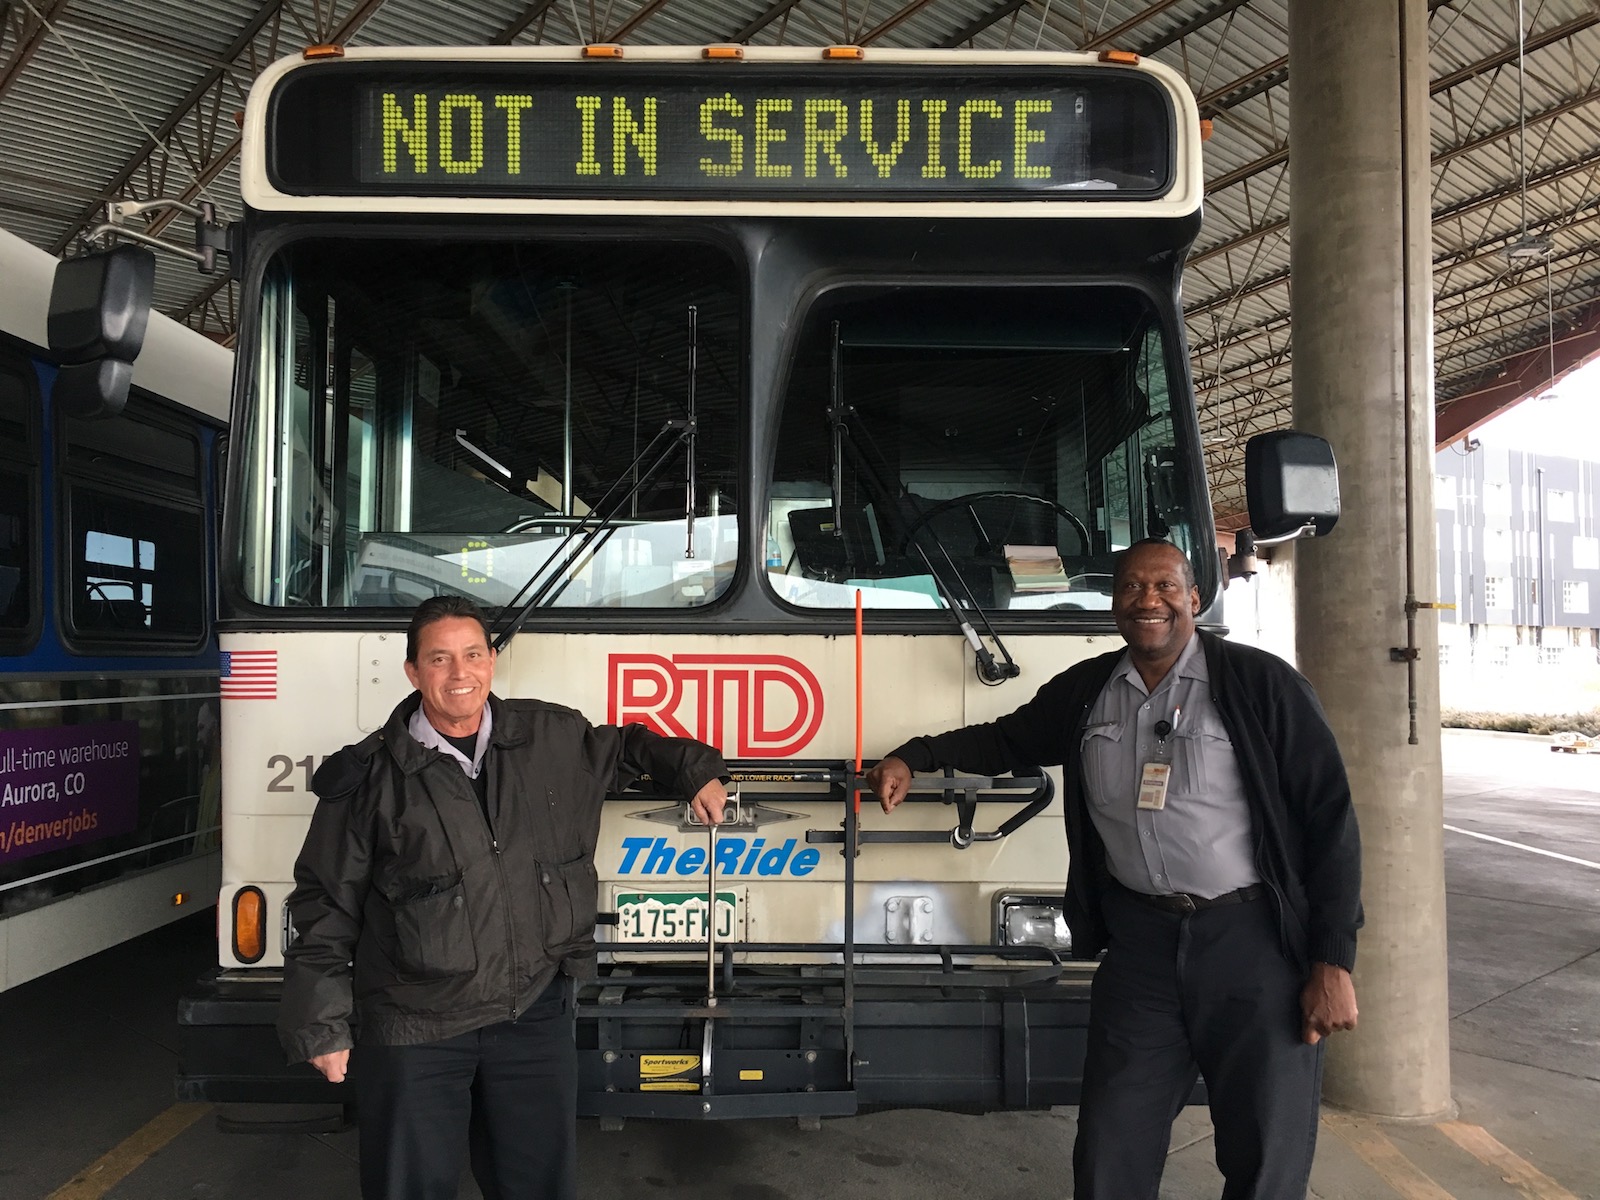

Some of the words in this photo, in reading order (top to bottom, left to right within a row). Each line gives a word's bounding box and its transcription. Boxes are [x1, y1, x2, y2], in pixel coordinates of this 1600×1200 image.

[383, 93, 532, 173] NOT
[575, 96, 657, 175] IN
[699, 92, 1053, 178] SERVICE
[608, 653, 824, 757] RTD
[59, 739, 129, 765] warehouse
[1, 781, 59, 807] Aurora,
[64, 772, 85, 796] CO
[267, 754, 333, 792] 21
